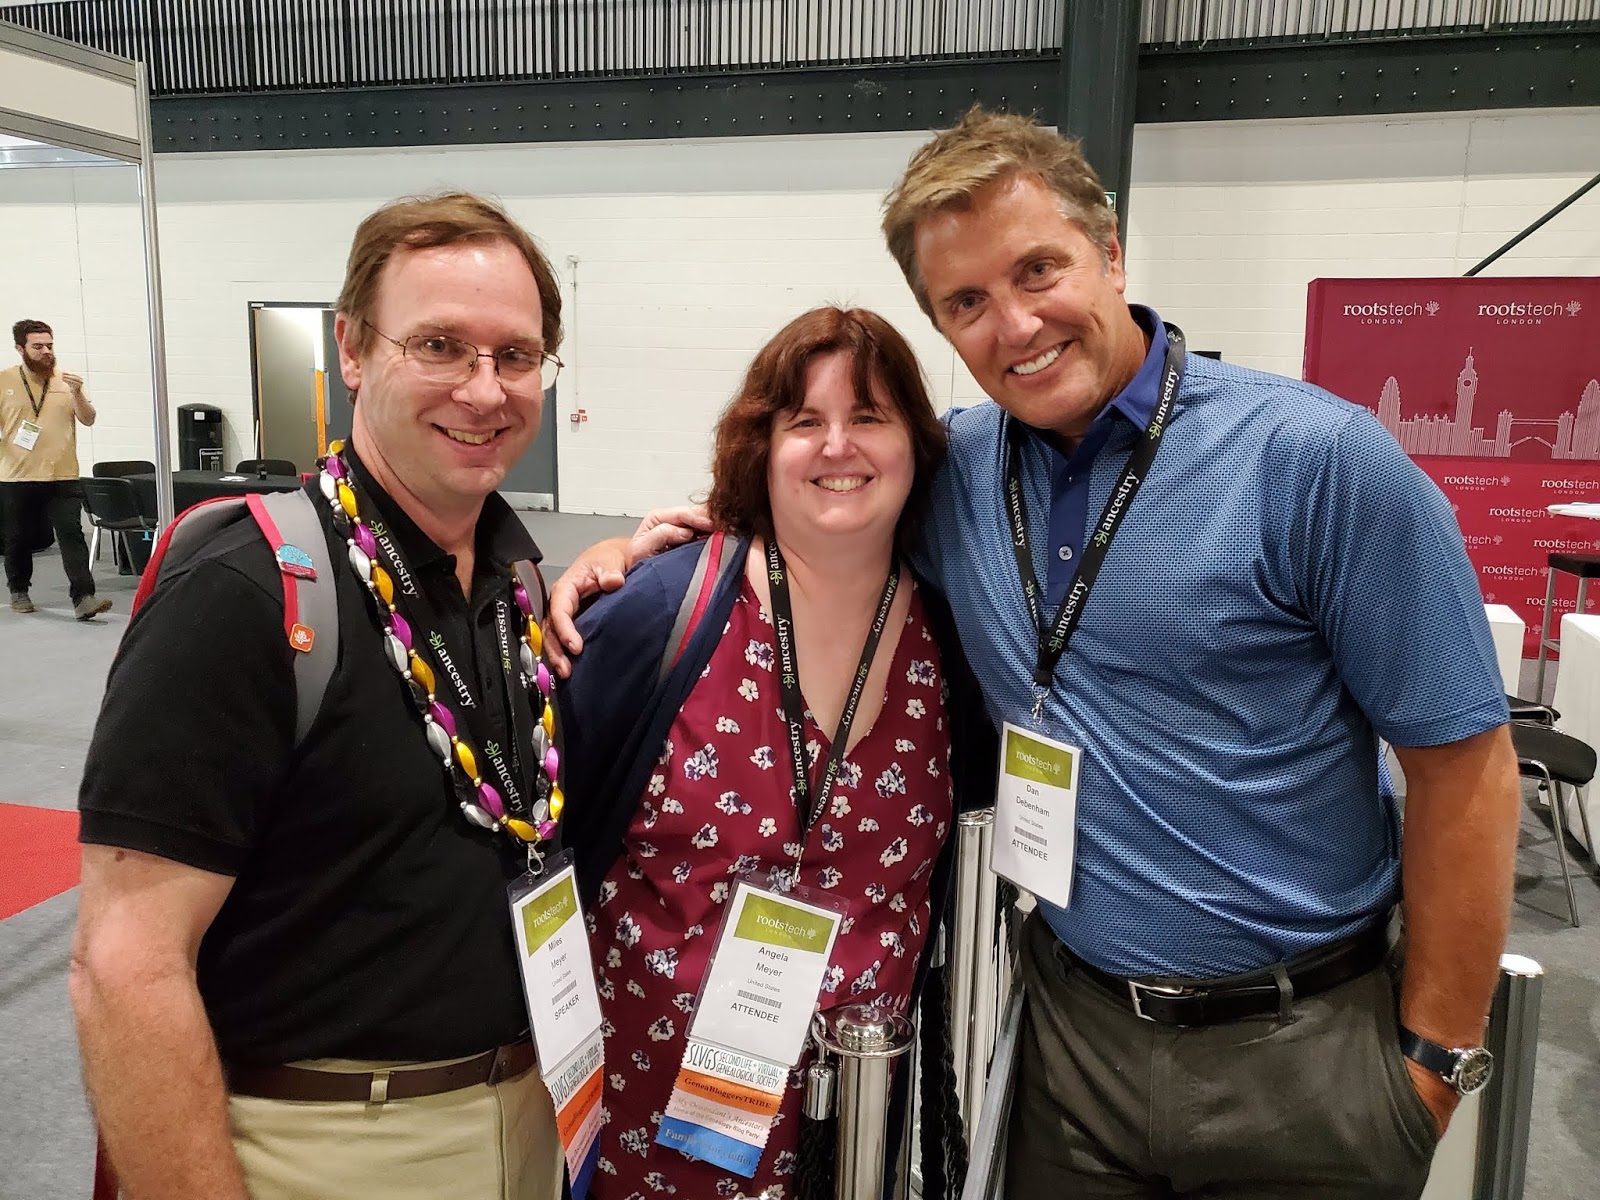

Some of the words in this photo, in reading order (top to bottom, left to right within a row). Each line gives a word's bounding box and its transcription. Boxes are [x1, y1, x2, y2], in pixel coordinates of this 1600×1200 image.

[1343, 301, 1423, 317] rootstech
[1477, 301, 1563, 317] rootstech
[1156, 367, 1180, 425] ancestry
[1443, 475, 1499, 486] rootstech
[1541, 479, 1599, 490] rootstech
[1102, 471, 1140, 531] ancestry
[1489, 506, 1546, 518] rootstech
[1012, 493, 1026, 548] ancestry
[1462, 534, 1492, 545] stech
[1533, 538, 1591, 550] rootstech
[378, 534, 417, 598] ancestry
[1482, 565, 1538, 576] rootstech
[873, 586, 897, 636] ancestry
[1055, 578, 1088, 638] ancestry
[495, 598, 509, 657] ancestry
[777, 617, 791, 672] ancestry
[437, 648, 475, 708] ancestry
[842, 677, 865, 728] ancestry
[790, 720, 802, 779] ancestry
[1016, 750, 1053, 773] rootstech
[493, 755, 524, 814] ancestry
[1026, 784, 1040, 797] Dan
[1016, 796, 1050, 817] Debenham
[1011, 838, 1048, 861] ATTENDEE
[533, 902, 563, 928] rootstech
[756, 914, 806, 937] rootstech
[548, 936, 563, 952] Miles
[758, 946, 789, 963] Angela
[550, 952, 567, 970] Meyer
[755, 962, 783, 977] Meyer
[747, 977, 764, 988] United
[554, 993, 580, 1021] SPEAKER
[730, 1002, 780, 1023] ATTENDEE
[687, 1043, 719, 1071] SLVGS
[715, 1062, 755, 1083] GENEALOGICAL
[756, 1073, 780, 1089] SOCIETY
[684, 1077, 772, 1110] GeneaBloggersTRIBE
